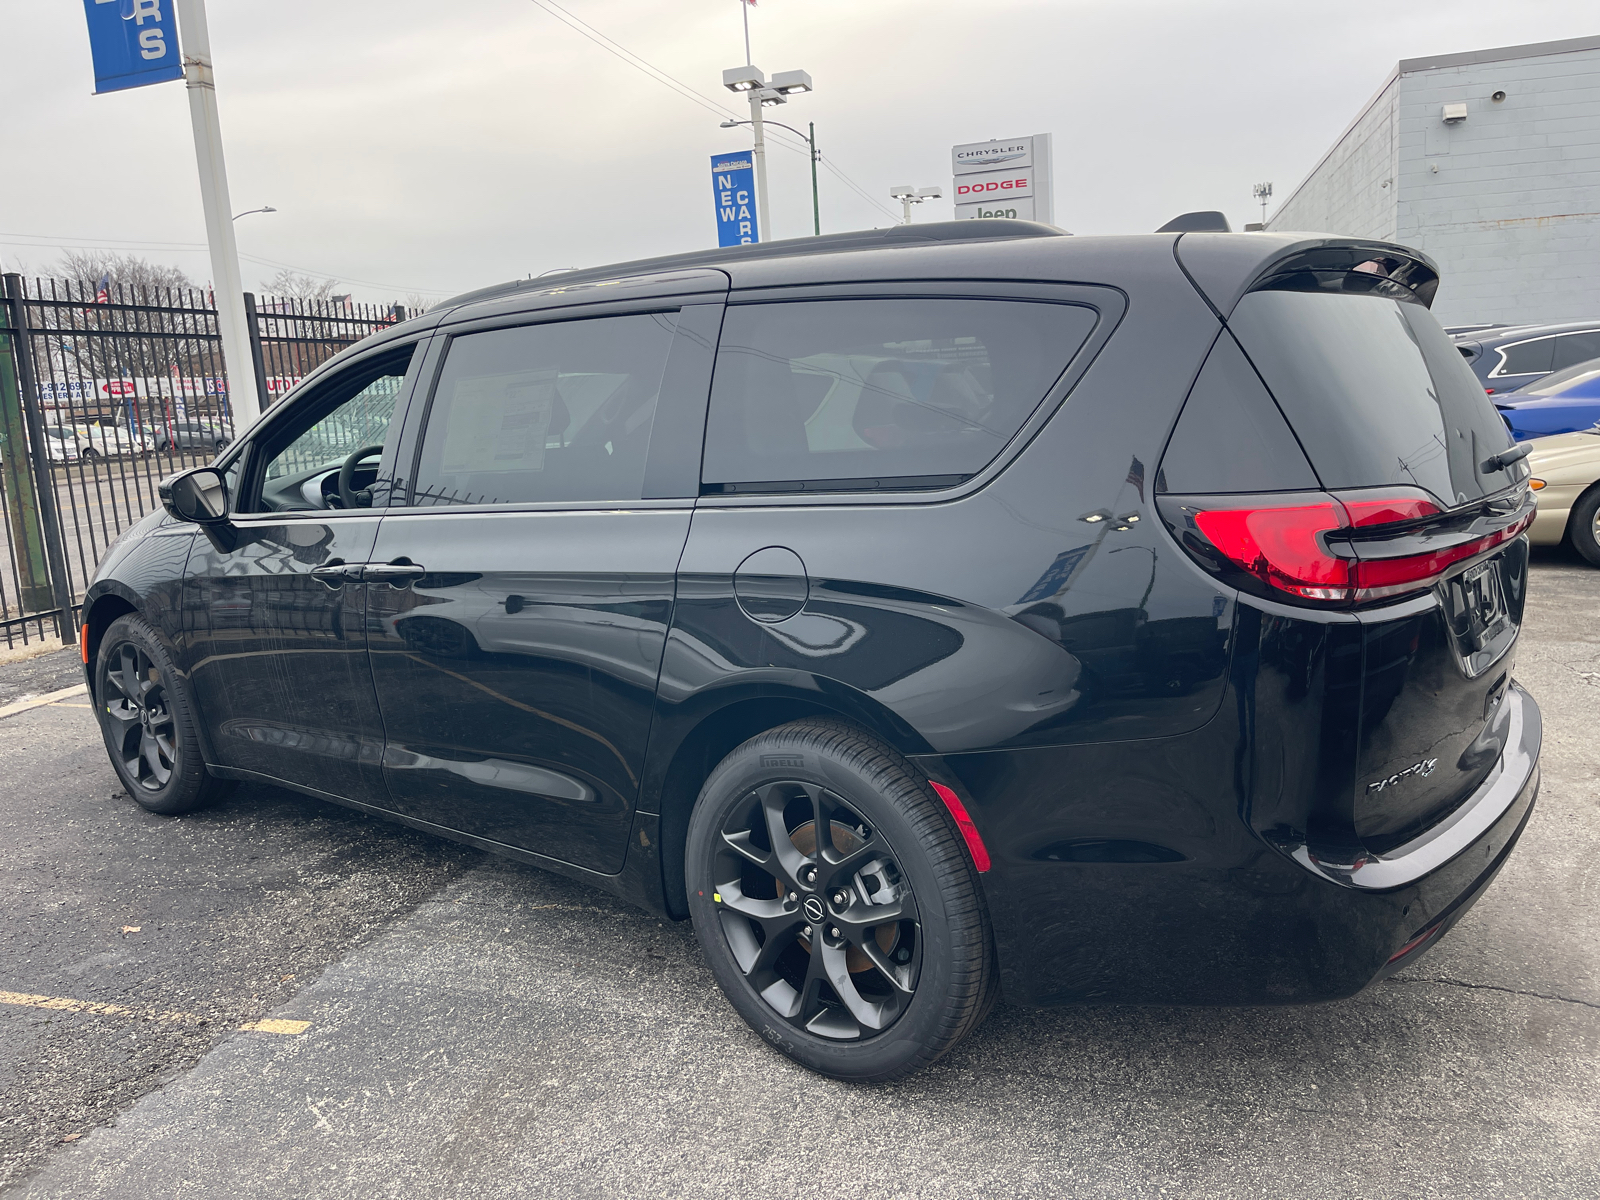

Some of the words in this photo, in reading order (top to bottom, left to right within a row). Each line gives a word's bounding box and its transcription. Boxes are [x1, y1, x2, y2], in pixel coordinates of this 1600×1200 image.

[957, 145, 1024, 158] CHRYSLER
[957, 178, 1028, 195] DODGE
[718, 174, 736, 222] NEW
[267, 379, 290, 391] UTO
[759, 754, 804, 768] PIRELLI
